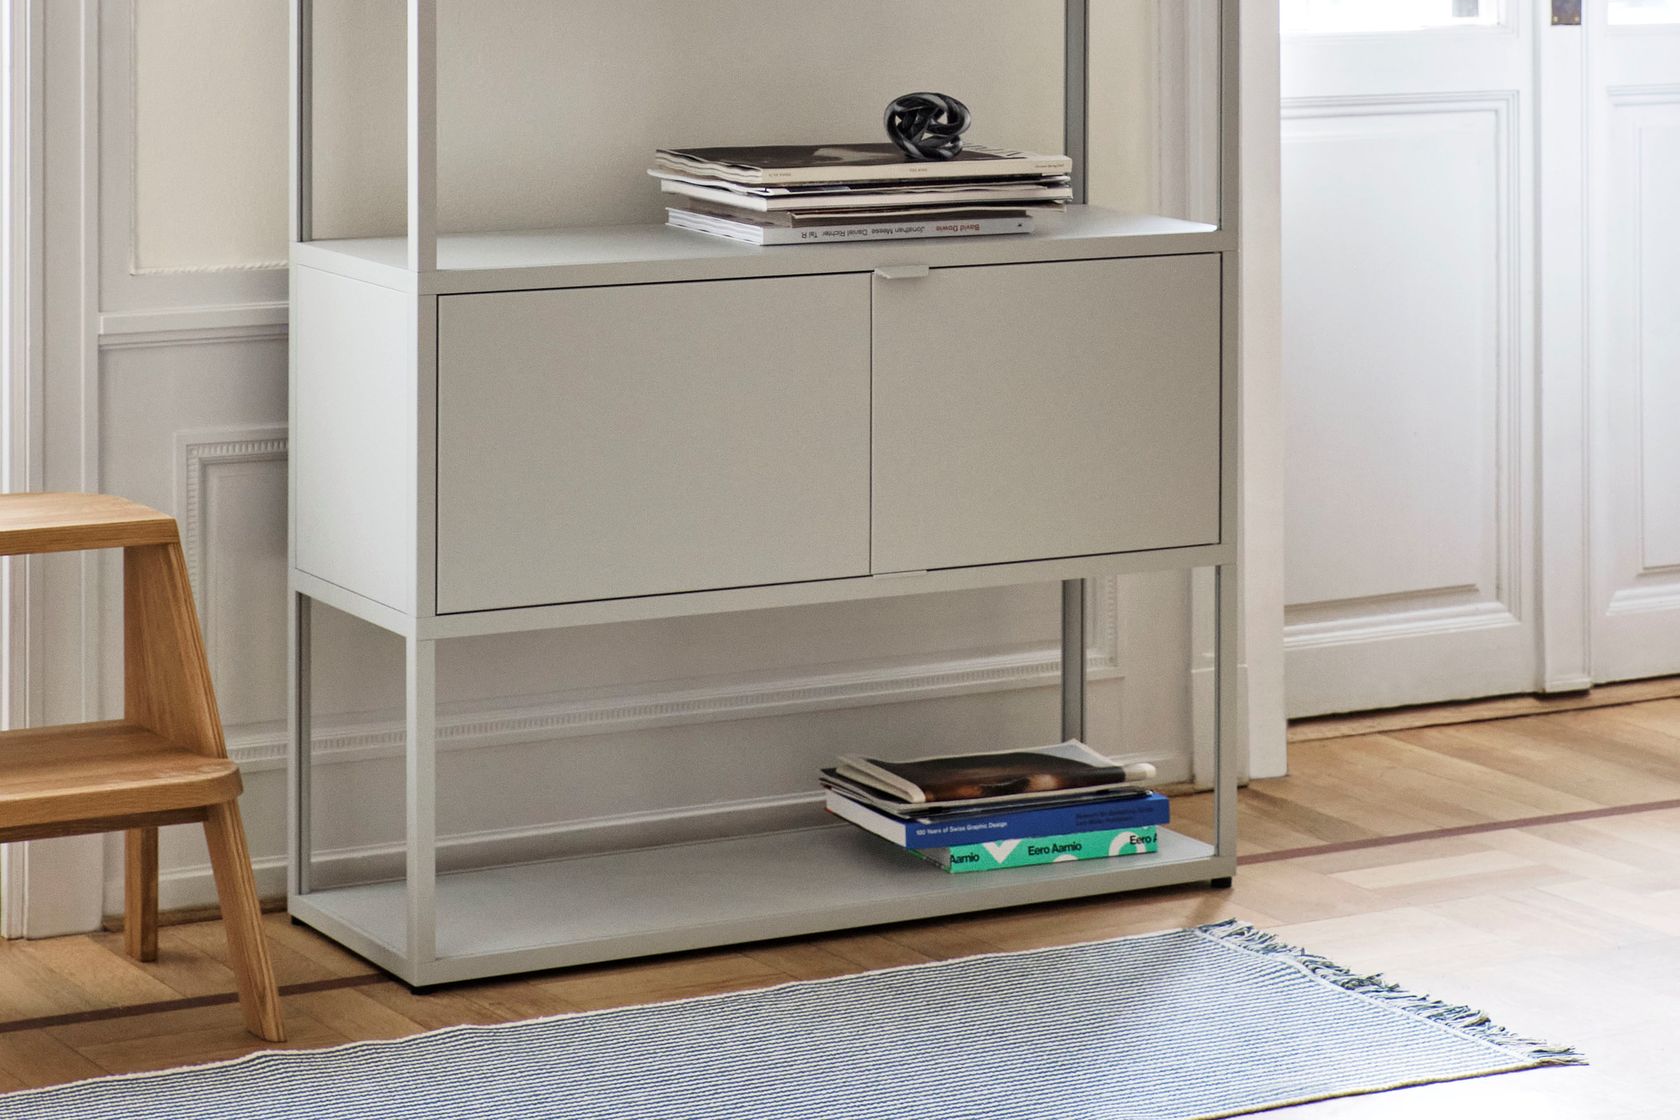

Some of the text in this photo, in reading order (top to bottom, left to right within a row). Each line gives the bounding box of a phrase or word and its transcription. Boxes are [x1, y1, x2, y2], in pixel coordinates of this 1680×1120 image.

[822, 228, 868, 238] Daniel Richter
[894, 225, 926, 234] Jonathan
[916, 828, 926, 836] 100
[927, 826, 942, 835] Years
[949, 824, 966, 832] Swiss
[966, 823, 988, 832] Graphic
[988, 821, 1008, 829] Design
[1129, 834, 1152, 845] Eero
[1027, 845, 1051, 856] Eero
